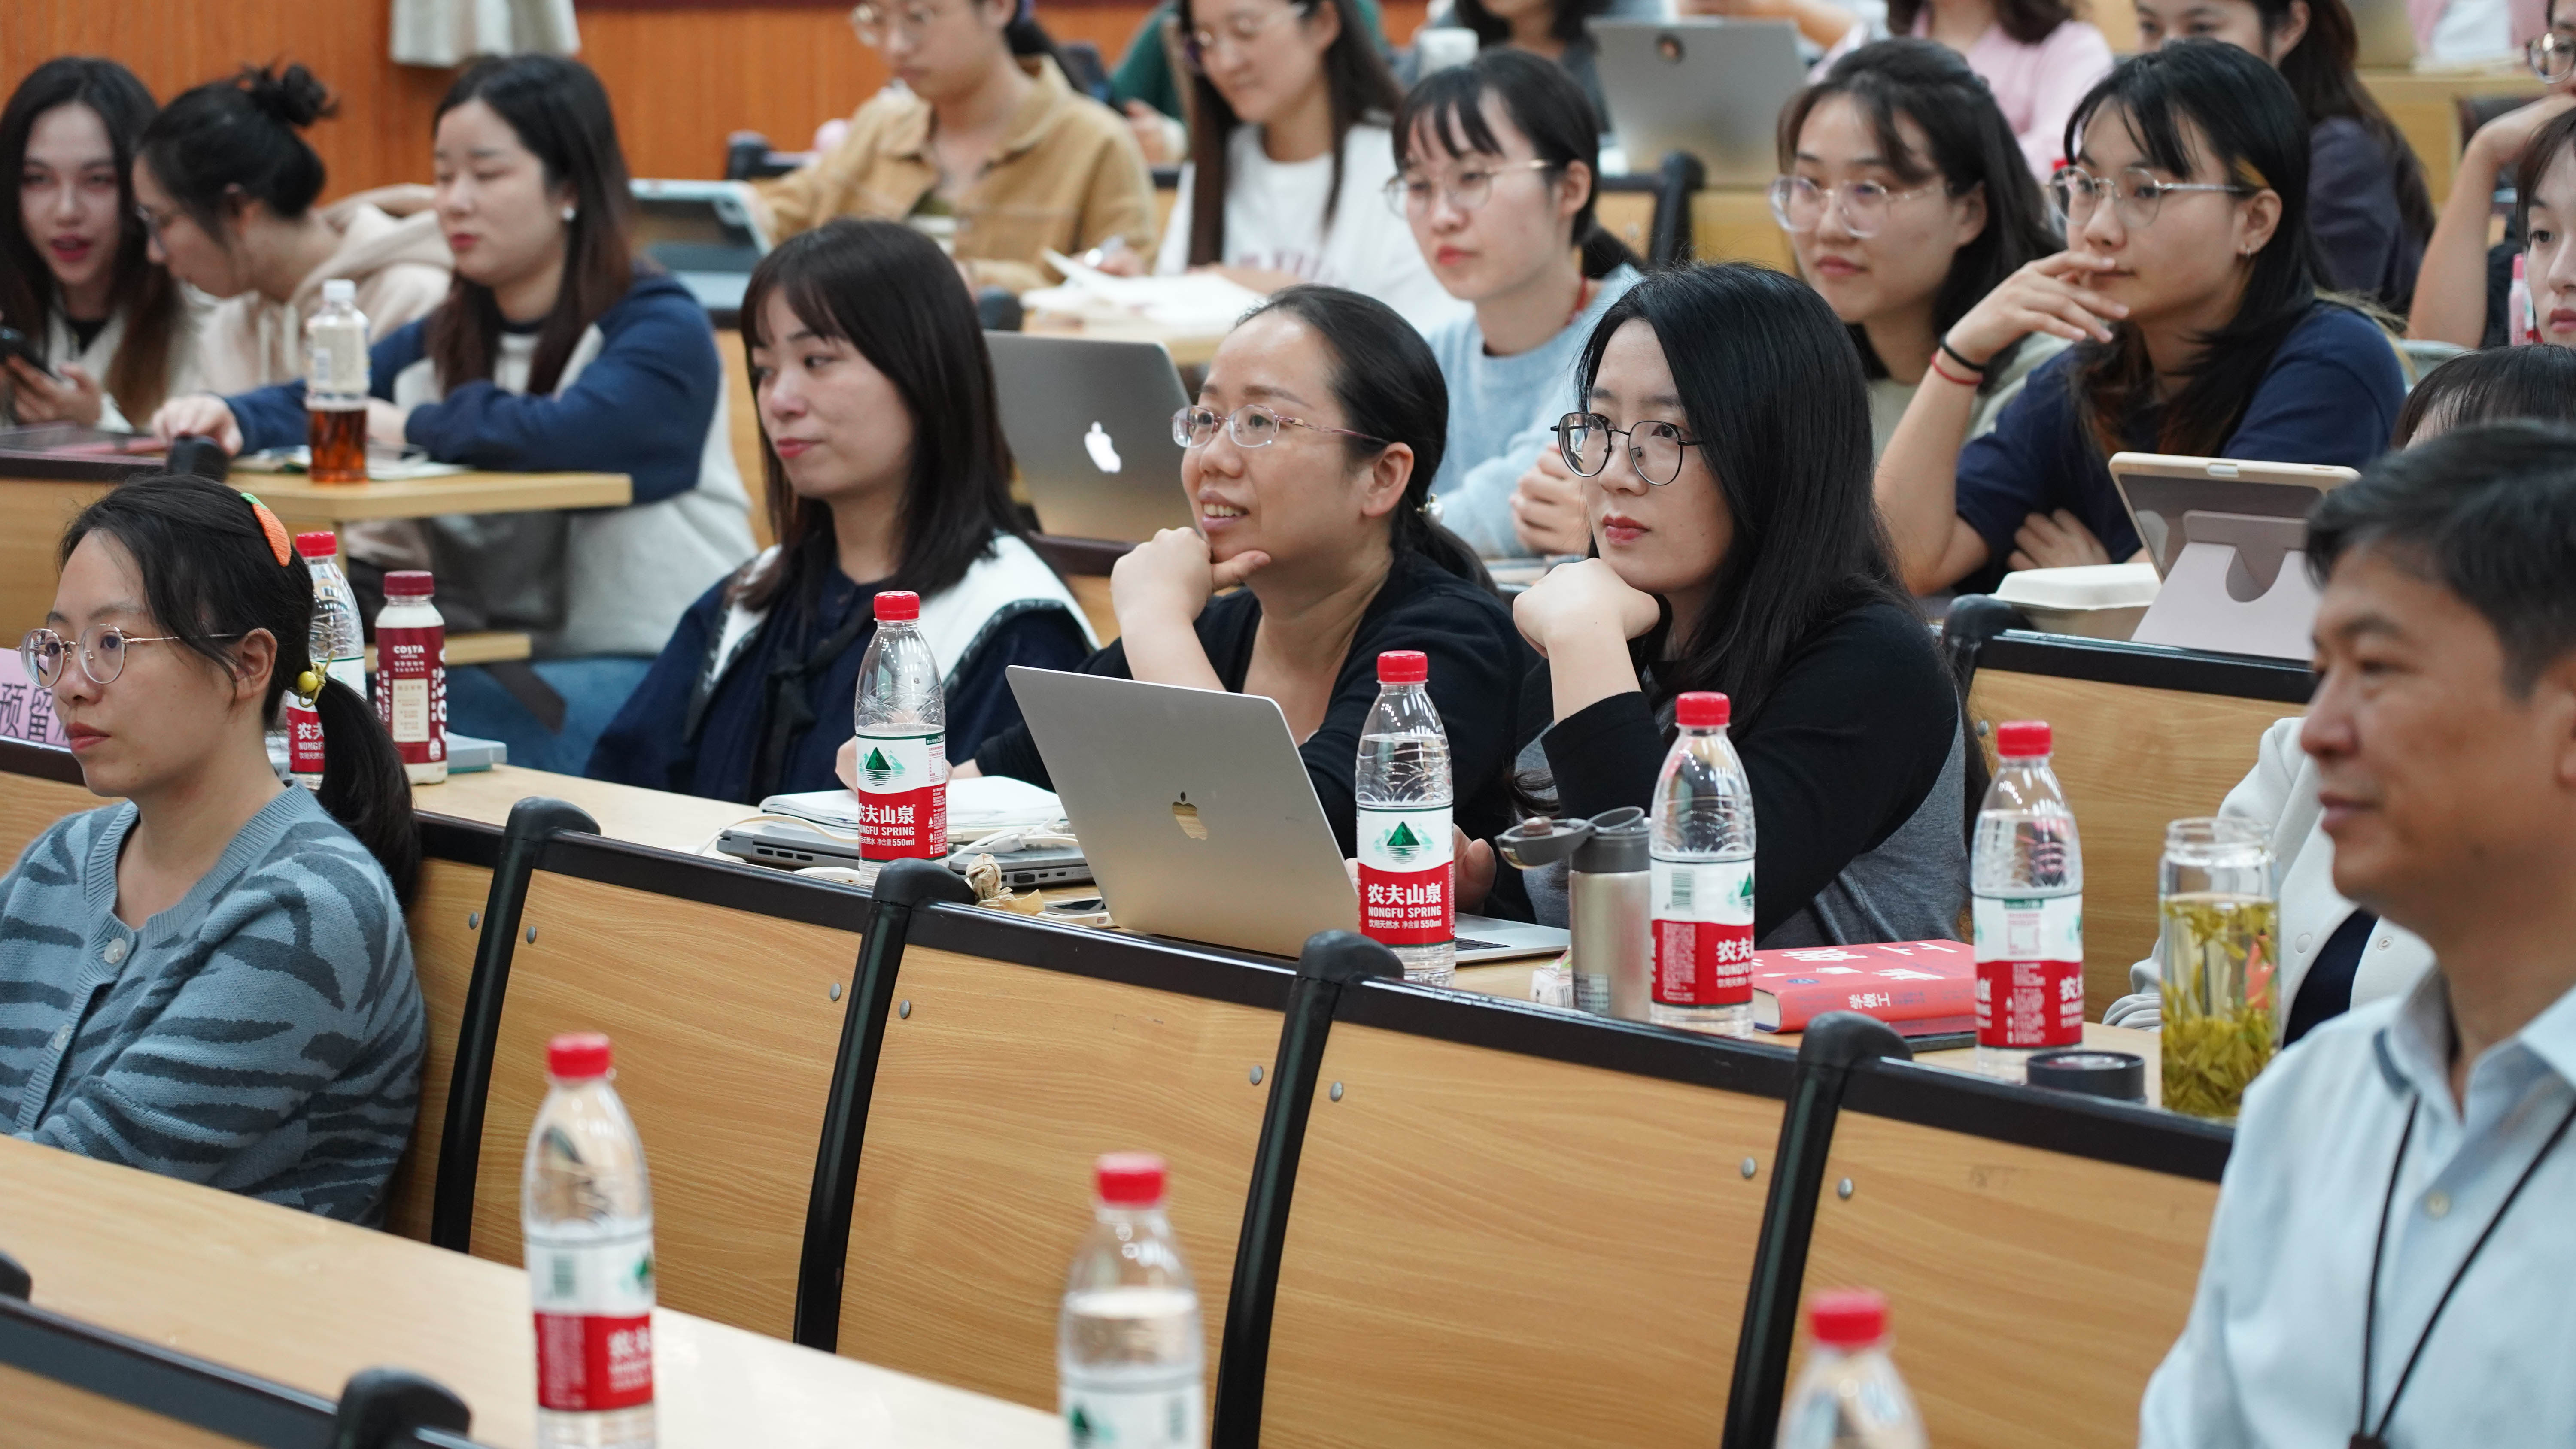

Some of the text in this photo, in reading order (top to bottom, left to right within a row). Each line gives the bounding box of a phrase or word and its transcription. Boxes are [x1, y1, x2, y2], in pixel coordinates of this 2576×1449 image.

[393, 645, 425, 655] COSTA
[0, 683, 67, 743] 预留
[859, 824, 915, 836] ONGFU SPRING
[1367, 882, 1442, 905] 农夫山泉
[1368, 905, 1442, 918] NONGFU SPRING
[1716, 935, 1754, 963] 农夫
